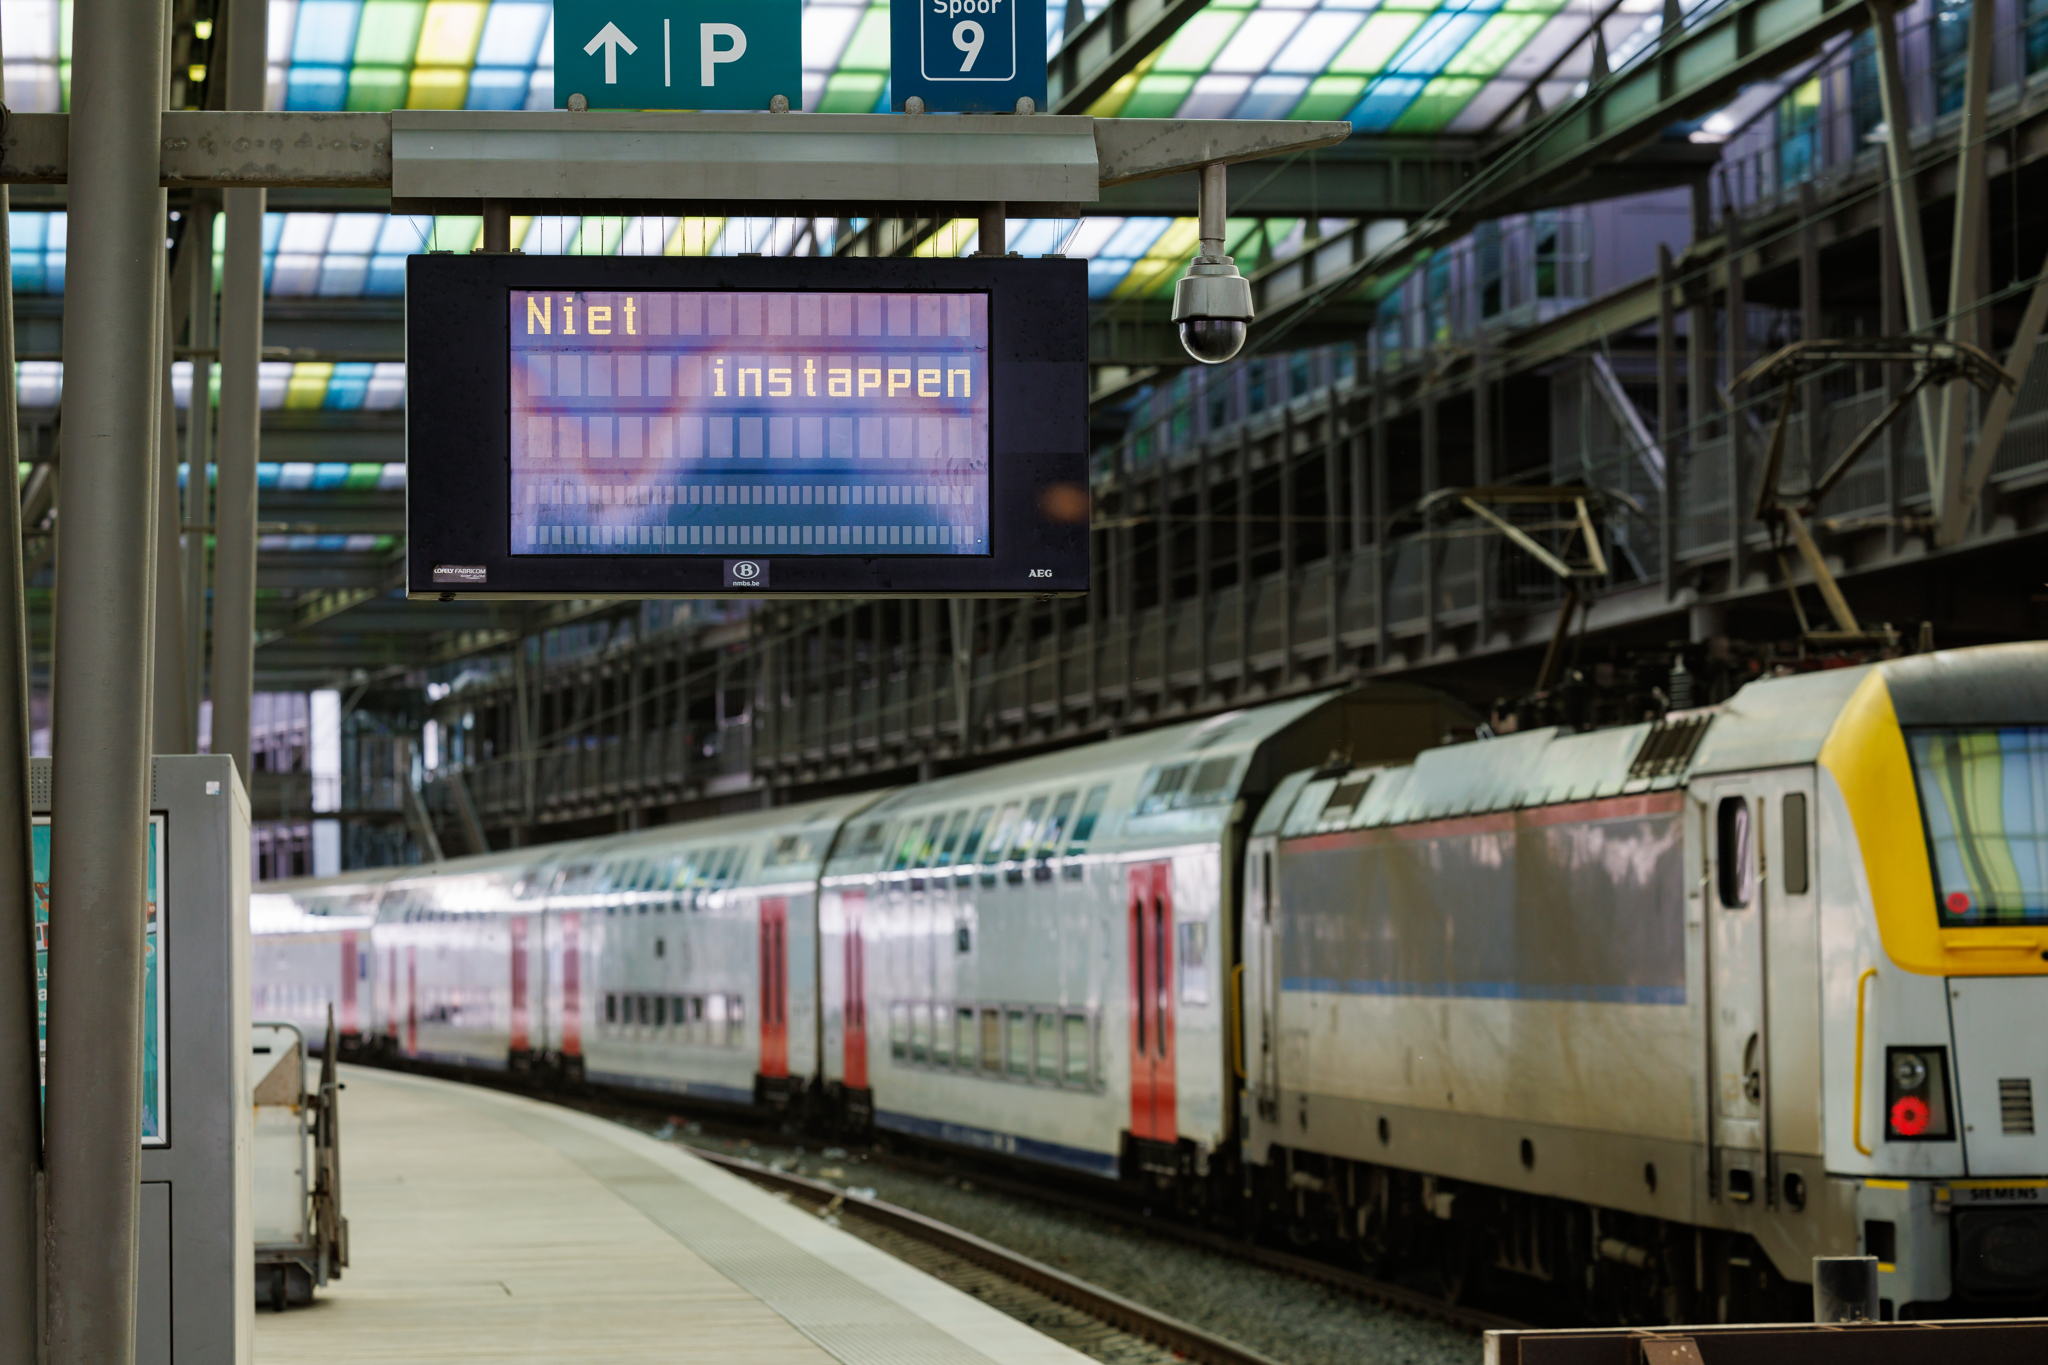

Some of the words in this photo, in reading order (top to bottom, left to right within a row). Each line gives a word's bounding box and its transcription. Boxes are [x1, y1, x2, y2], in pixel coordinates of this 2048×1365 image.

[933, 0, 1001, 19] Spoor
[700, 22, 747, 87] P
[952, 20, 985, 72] 9
[527, 296, 637, 335] Niet
[713, 358, 971, 398] instappen
[1028, 569, 1053, 578] AEG
[1969, 1186, 2039, 1201] SIEMENS
